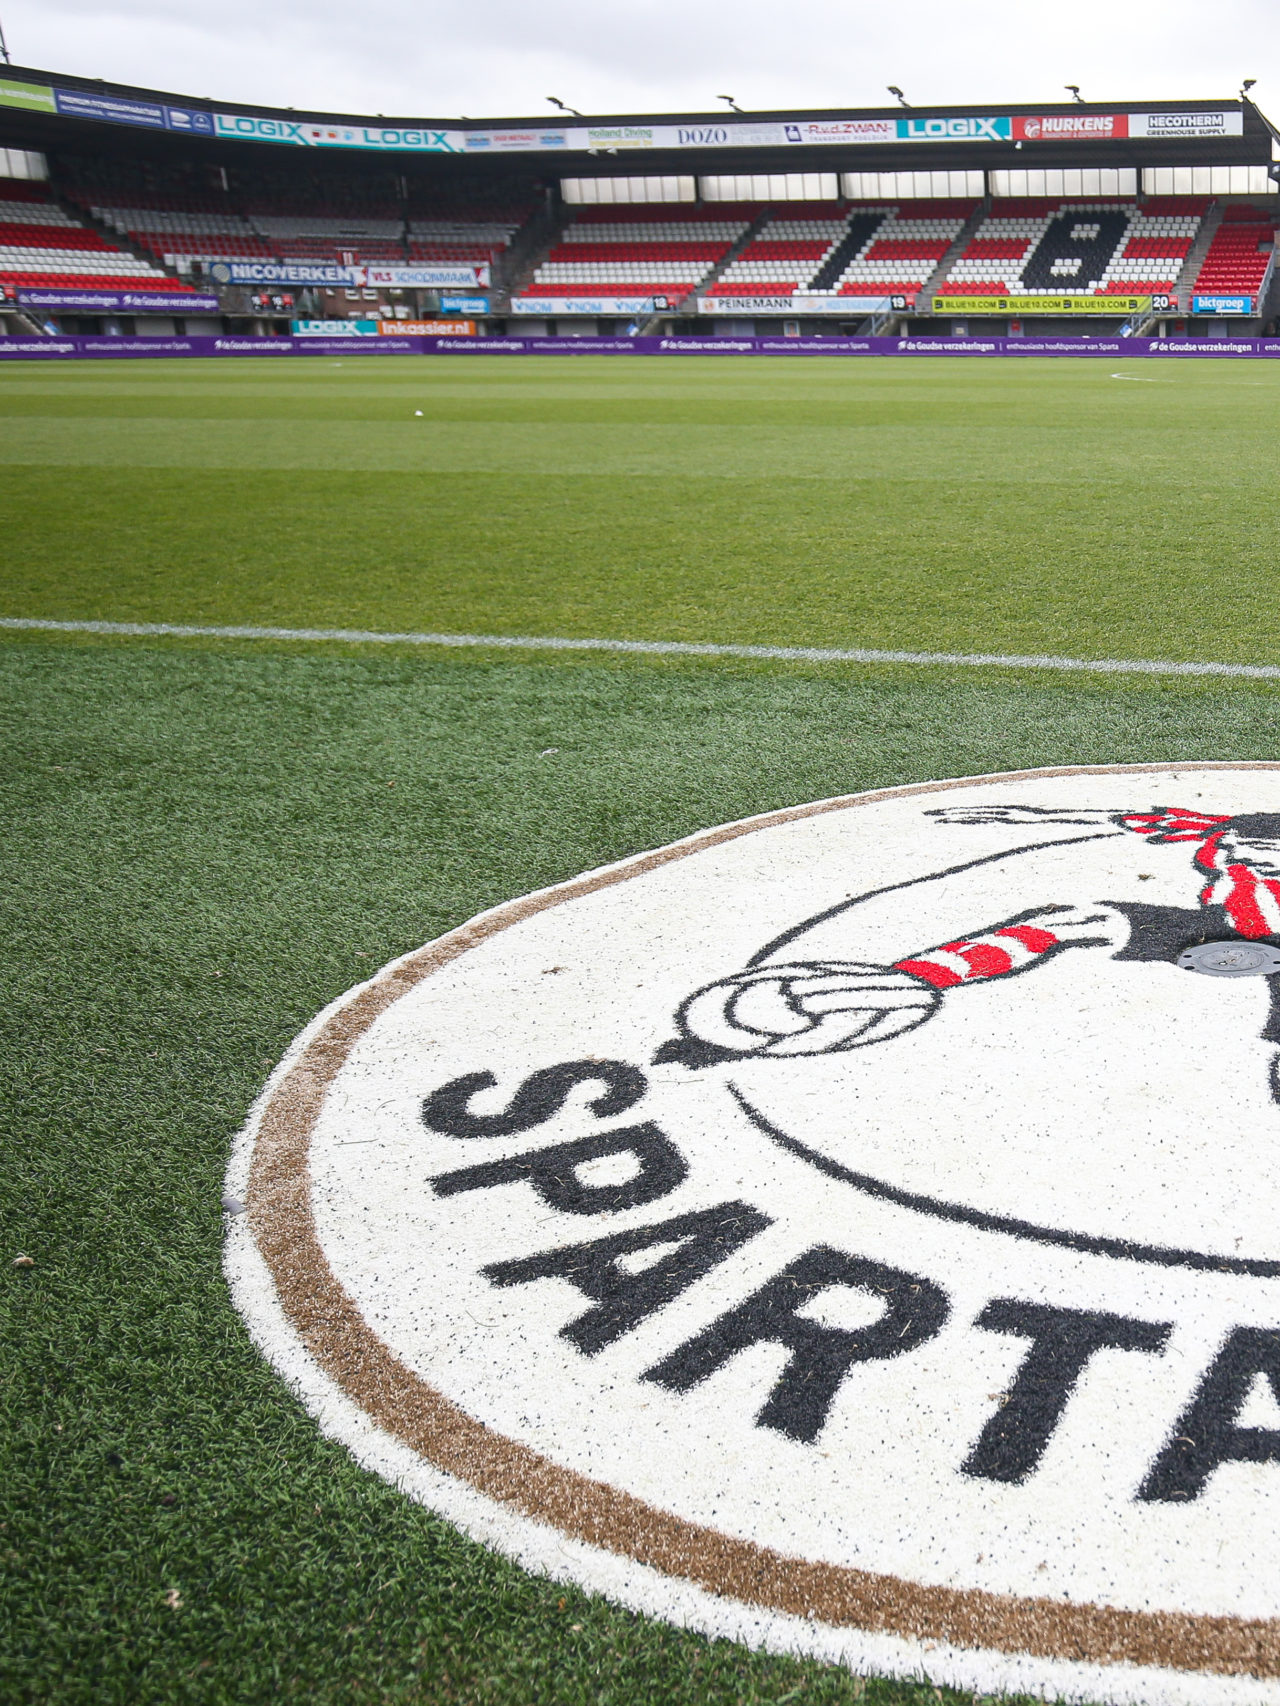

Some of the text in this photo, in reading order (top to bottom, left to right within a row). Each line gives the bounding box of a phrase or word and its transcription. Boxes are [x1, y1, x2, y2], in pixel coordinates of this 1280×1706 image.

[1042, 116, 1114, 132] HURKENS
[1149, 115, 1223, 127] HECOTHERM
[217, 115, 306, 144] LOGIX
[907, 118, 1003, 140] LOGIX
[1198, 127, 1227, 135] SUPPLY
[363, 129, 451, 151] LOGIX
[678, 128, 727, 145] DOZO
[231, 264, 350, 281] NICOVERKEN
[718, 298, 792, 308] PEINEMANN
[892, 297, 905, 308] 19
[946, 299, 996, 308] BLUE10.COM
[1009, 299, 1061, 308] BLUE10.COM
[1074, 299, 1127, 308] BLUE10.COM
[1153, 296, 1168, 308] 20
[1198, 297, 1244, 309] bictgroep
[298, 320, 359, 335] LOGIX
[382, 321, 470, 336] Inkassier.nl
[907, 342, 995, 352] de Goudse verzekeringen
[1158, 343, 1252, 353] de Goudse verzekeringen
